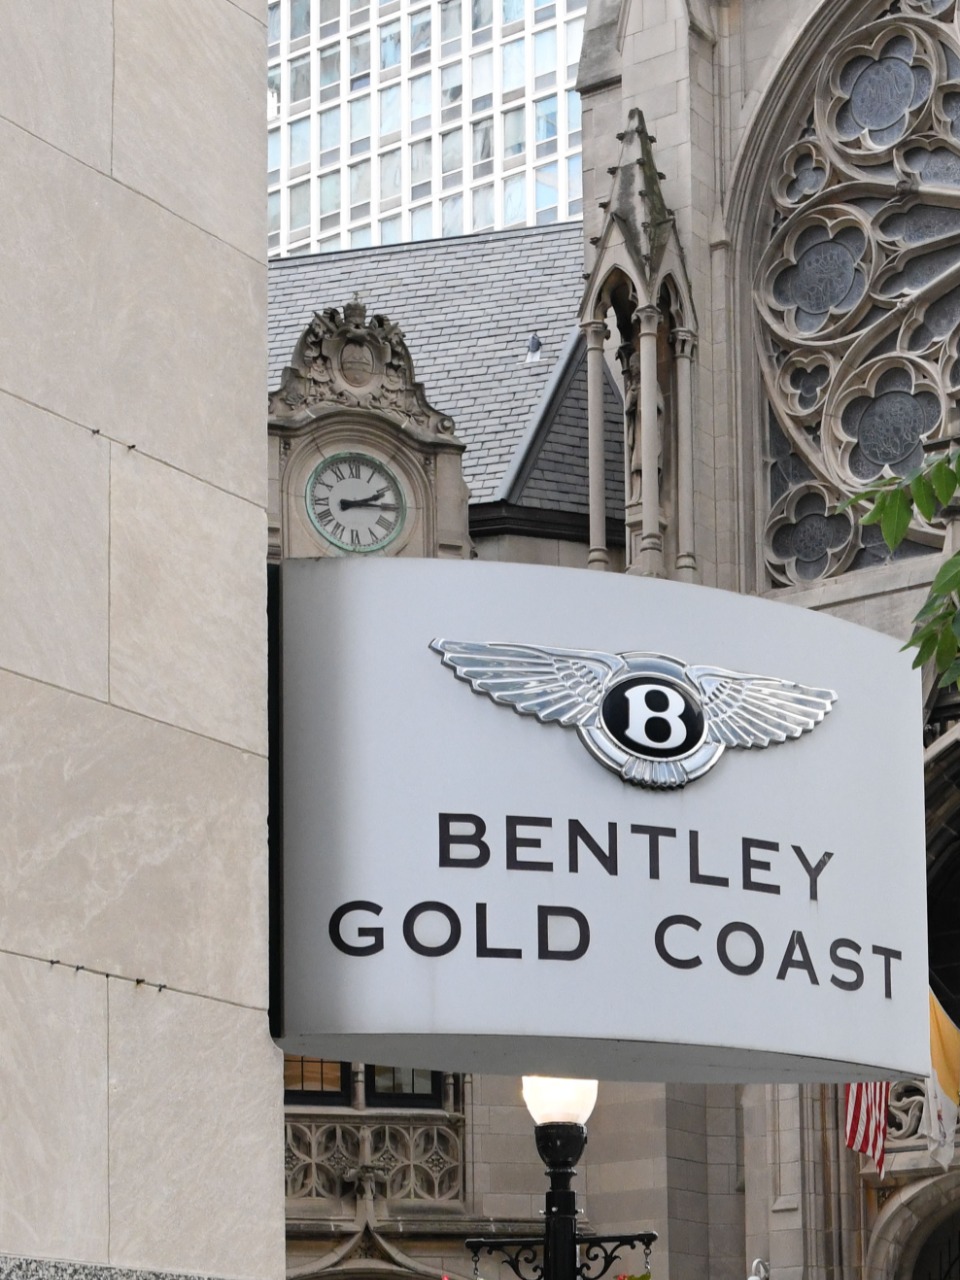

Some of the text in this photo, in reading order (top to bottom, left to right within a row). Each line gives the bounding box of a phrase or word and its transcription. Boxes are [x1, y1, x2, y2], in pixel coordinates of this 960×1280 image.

[438, 812, 834, 902] BENTLEY
[327, 900, 902, 999] GOLD COAST
